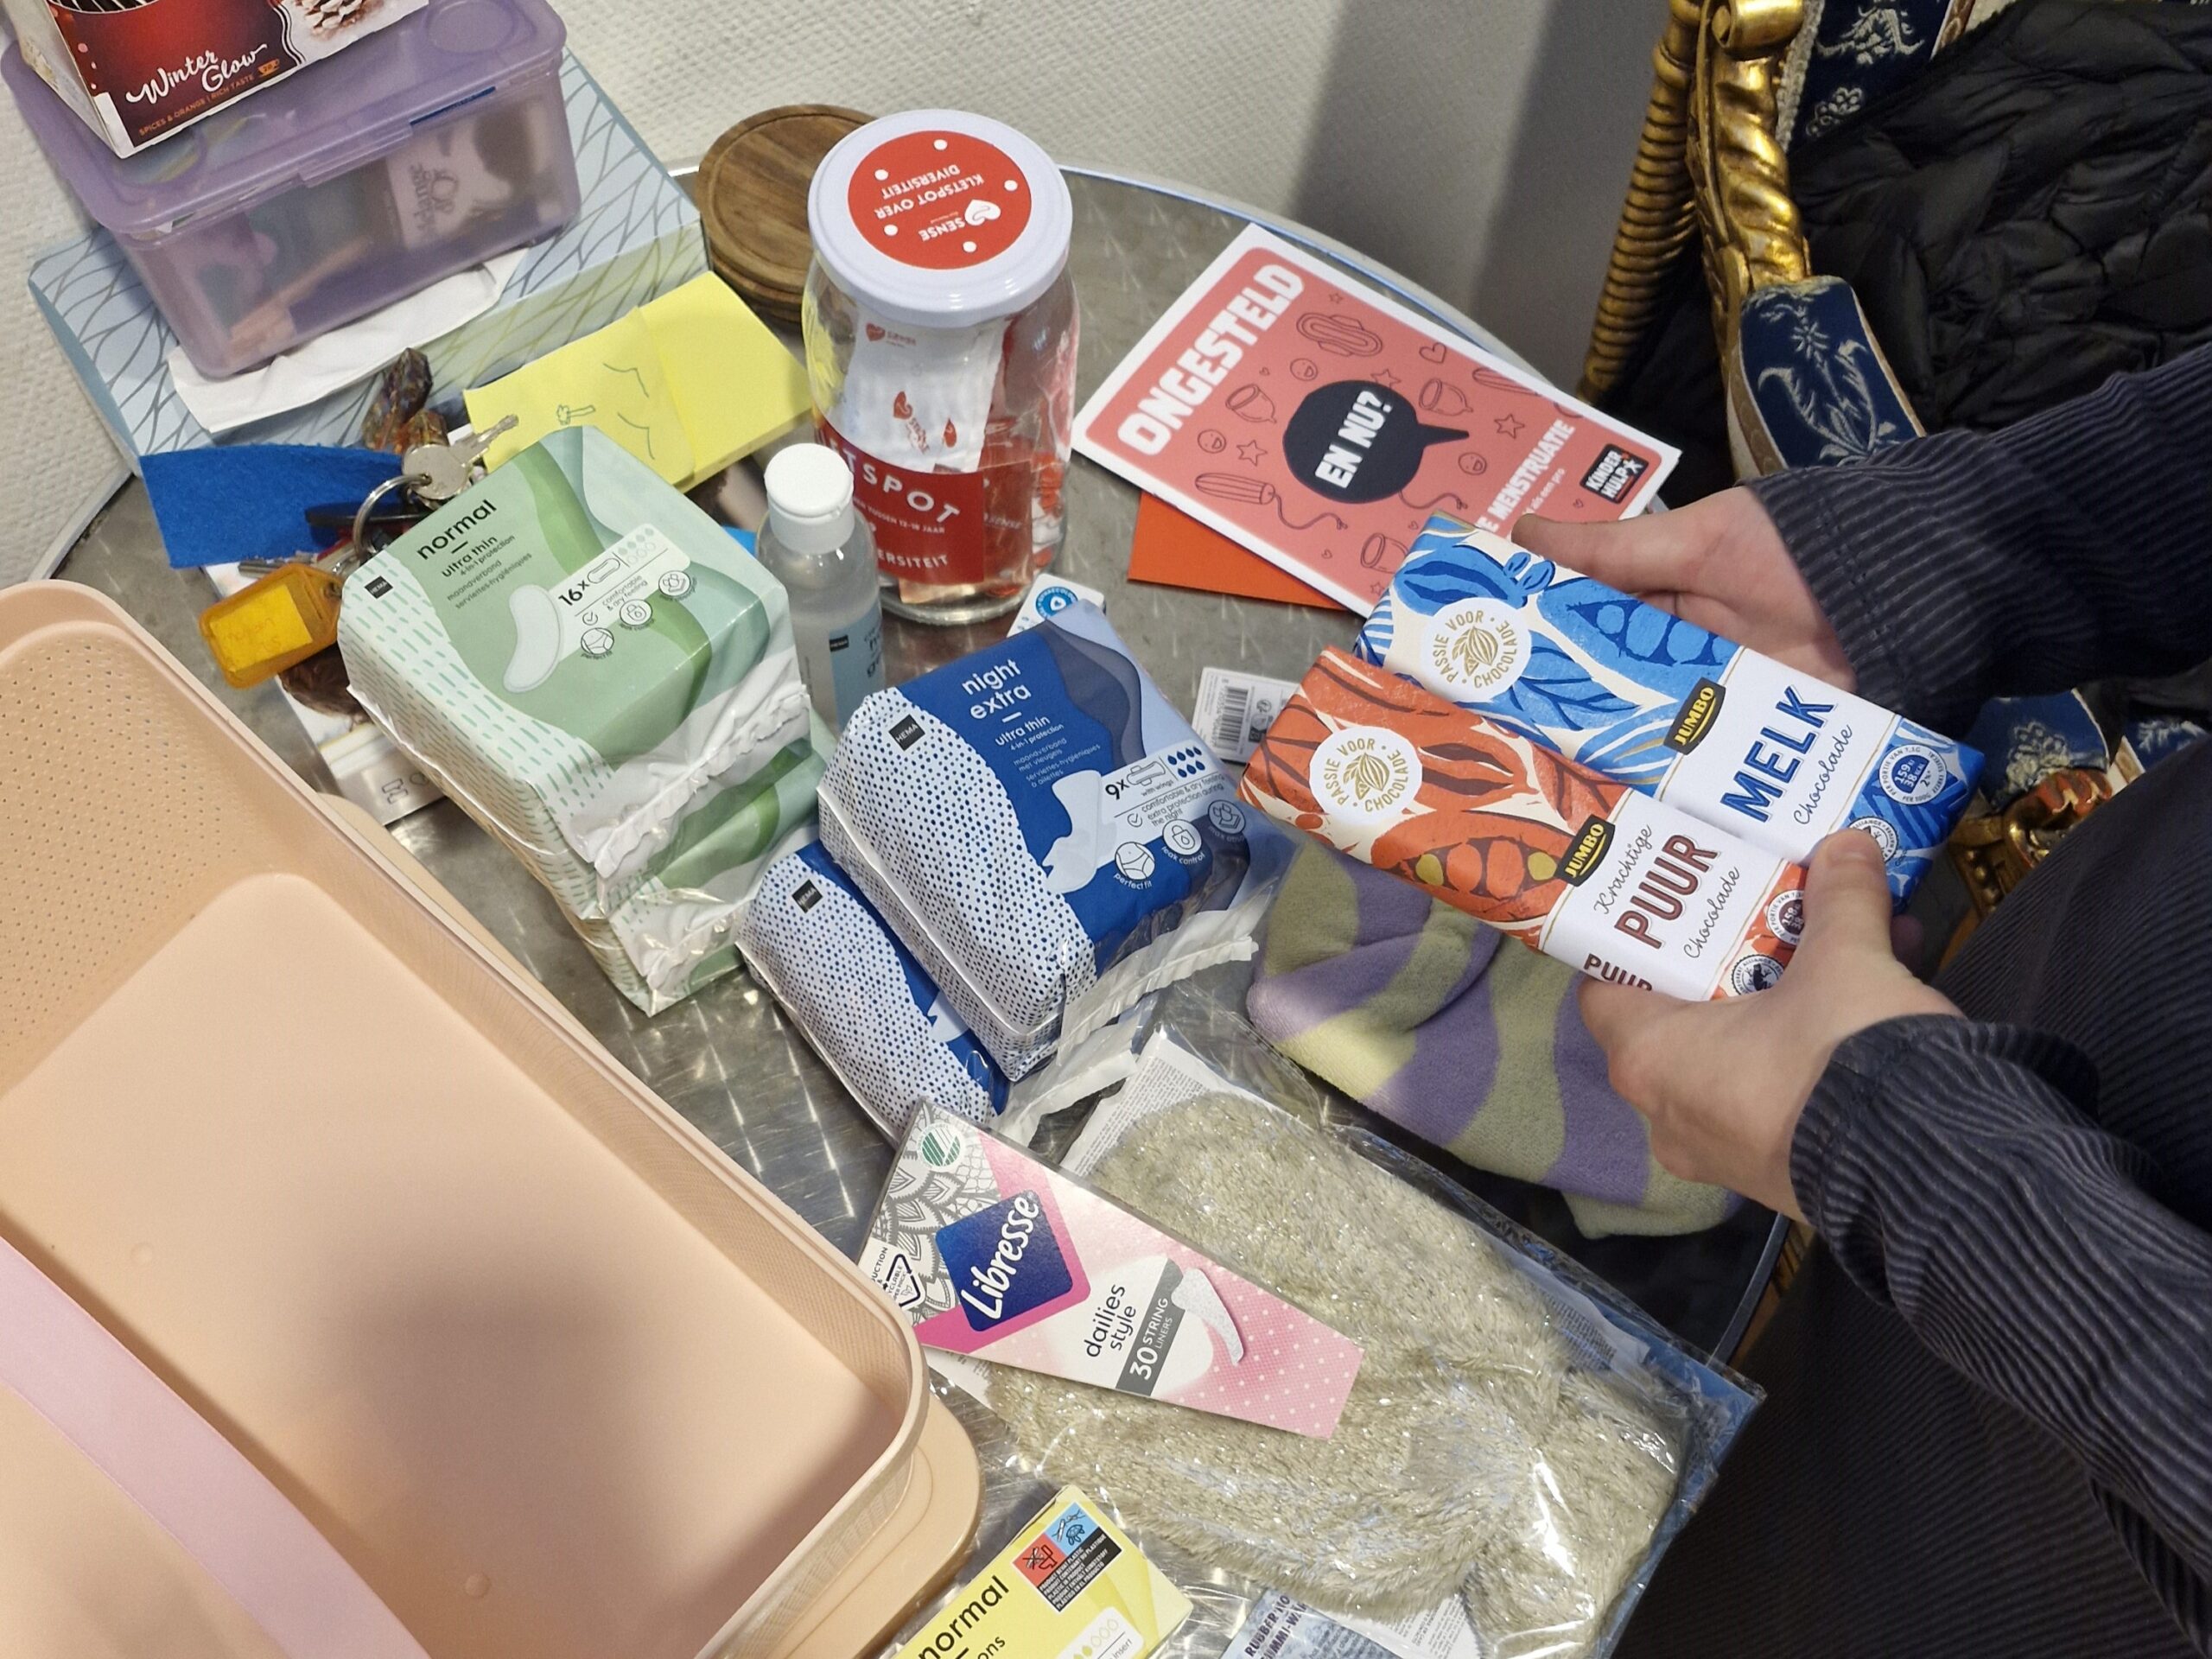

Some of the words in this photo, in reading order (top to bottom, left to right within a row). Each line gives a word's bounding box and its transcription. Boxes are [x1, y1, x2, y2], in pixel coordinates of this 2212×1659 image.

[126, 50, 219, 104] Winter
[202, 44, 267, 92] Glow
[139, 118, 166, 136] SPICES
[174, 99, 206, 118] ORANGE
[211, 86, 230, 100] RICH
[231, 74, 255, 90] TASTE
[880, 164, 961, 200] DIVERSITEIT
[916, 174, 985, 207] KLETSPOT
[874, 199, 914, 219] OVER
[918, 217, 966, 242] SENSE
[1117, 264, 1306, 457] ONGESTELD
[1338, 391, 1392, 449] NU?
[1314, 443, 1363, 489] EN
[1474, 516, 1500, 533] E
[1487, 418, 1576, 521] MENSTRUATIE
[1586, 450, 1623, 490] KINDER
[1601, 467, 1630, 498] HULP
[416, 499, 497, 560] normal
[442, 554, 473, 577] ultra
[471, 537, 499, 556] thin
[478, 535, 516, 564] protection
[878, 549, 948, 569] ERSITEIT
[447, 559, 503, 601] maandverband
[602, 575, 643, 607] comfortable
[1445, 610, 1484, 631] VOOR
[1433, 633, 1459, 683] PASSIE
[1474, 620, 1517, 689] CHOCOLADE
[962, 658, 1021, 696] night
[969, 684, 1032, 719] extra
[1674, 687, 1714, 746] JUMBO
[895, 723, 918, 743] HEMA
[995, 728, 1026, 747] ultra
[1025, 715, 1051, 733] thin
[1029, 724, 1065, 745] protection
[1336, 738, 1376, 756] VOOR
[1013, 738, 1067, 766] maandverband
[1719, 684, 1835, 823] MELK
[1105, 779, 1129, 800] 9x
[1141, 786, 1155, 797] with
[1155, 779, 1175, 791] wings
[1323, 758, 1350, 805] PASSIE
[1365, 749, 1408, 812] CHOCOLADE
[1793, 723, 1853, 825] Chocolade
[1894, 764, 1911, 784] 159
[1904, 774, 1917, 787] 38
[1141, 788, 1185, 812] comfortable
[1147, 806, 1167, 820] extra
[1167, 792, 1203, 814] protection
[1152, 817, 1164, 827] the
[1164, 808, 1184, 821] night
[1161, 845, 1178, 861] leak
[1179, 852, 1205, 865] control
[1565, 823, 1605, 878] JUMBO
[1593, 824, 1655, 915] Krachtige
[1114, 873, 1143, 890] perfect
[1143, 880, 1153, 890] fit
[1614, 834, 1719, 949] PUUR
[1683, 866, 1742, 960] Chocolade
[961, 1196, 1039, 1320] Libresse
[888, 1266, 903, 1294] YCLABLE
[1084, 1283, 1125, 1357] dailies
[1110, 1306, 1136, 1351] style
[1143, 1297, 1168, 1344] STRING
[1155, 1317, 1173, 1350] LINERS
[1129, 1347, 1158, 1380] 30
[918, 1574, 1010, 1659] normal
[1244, 1612, 1279, 1657] RUBBER
